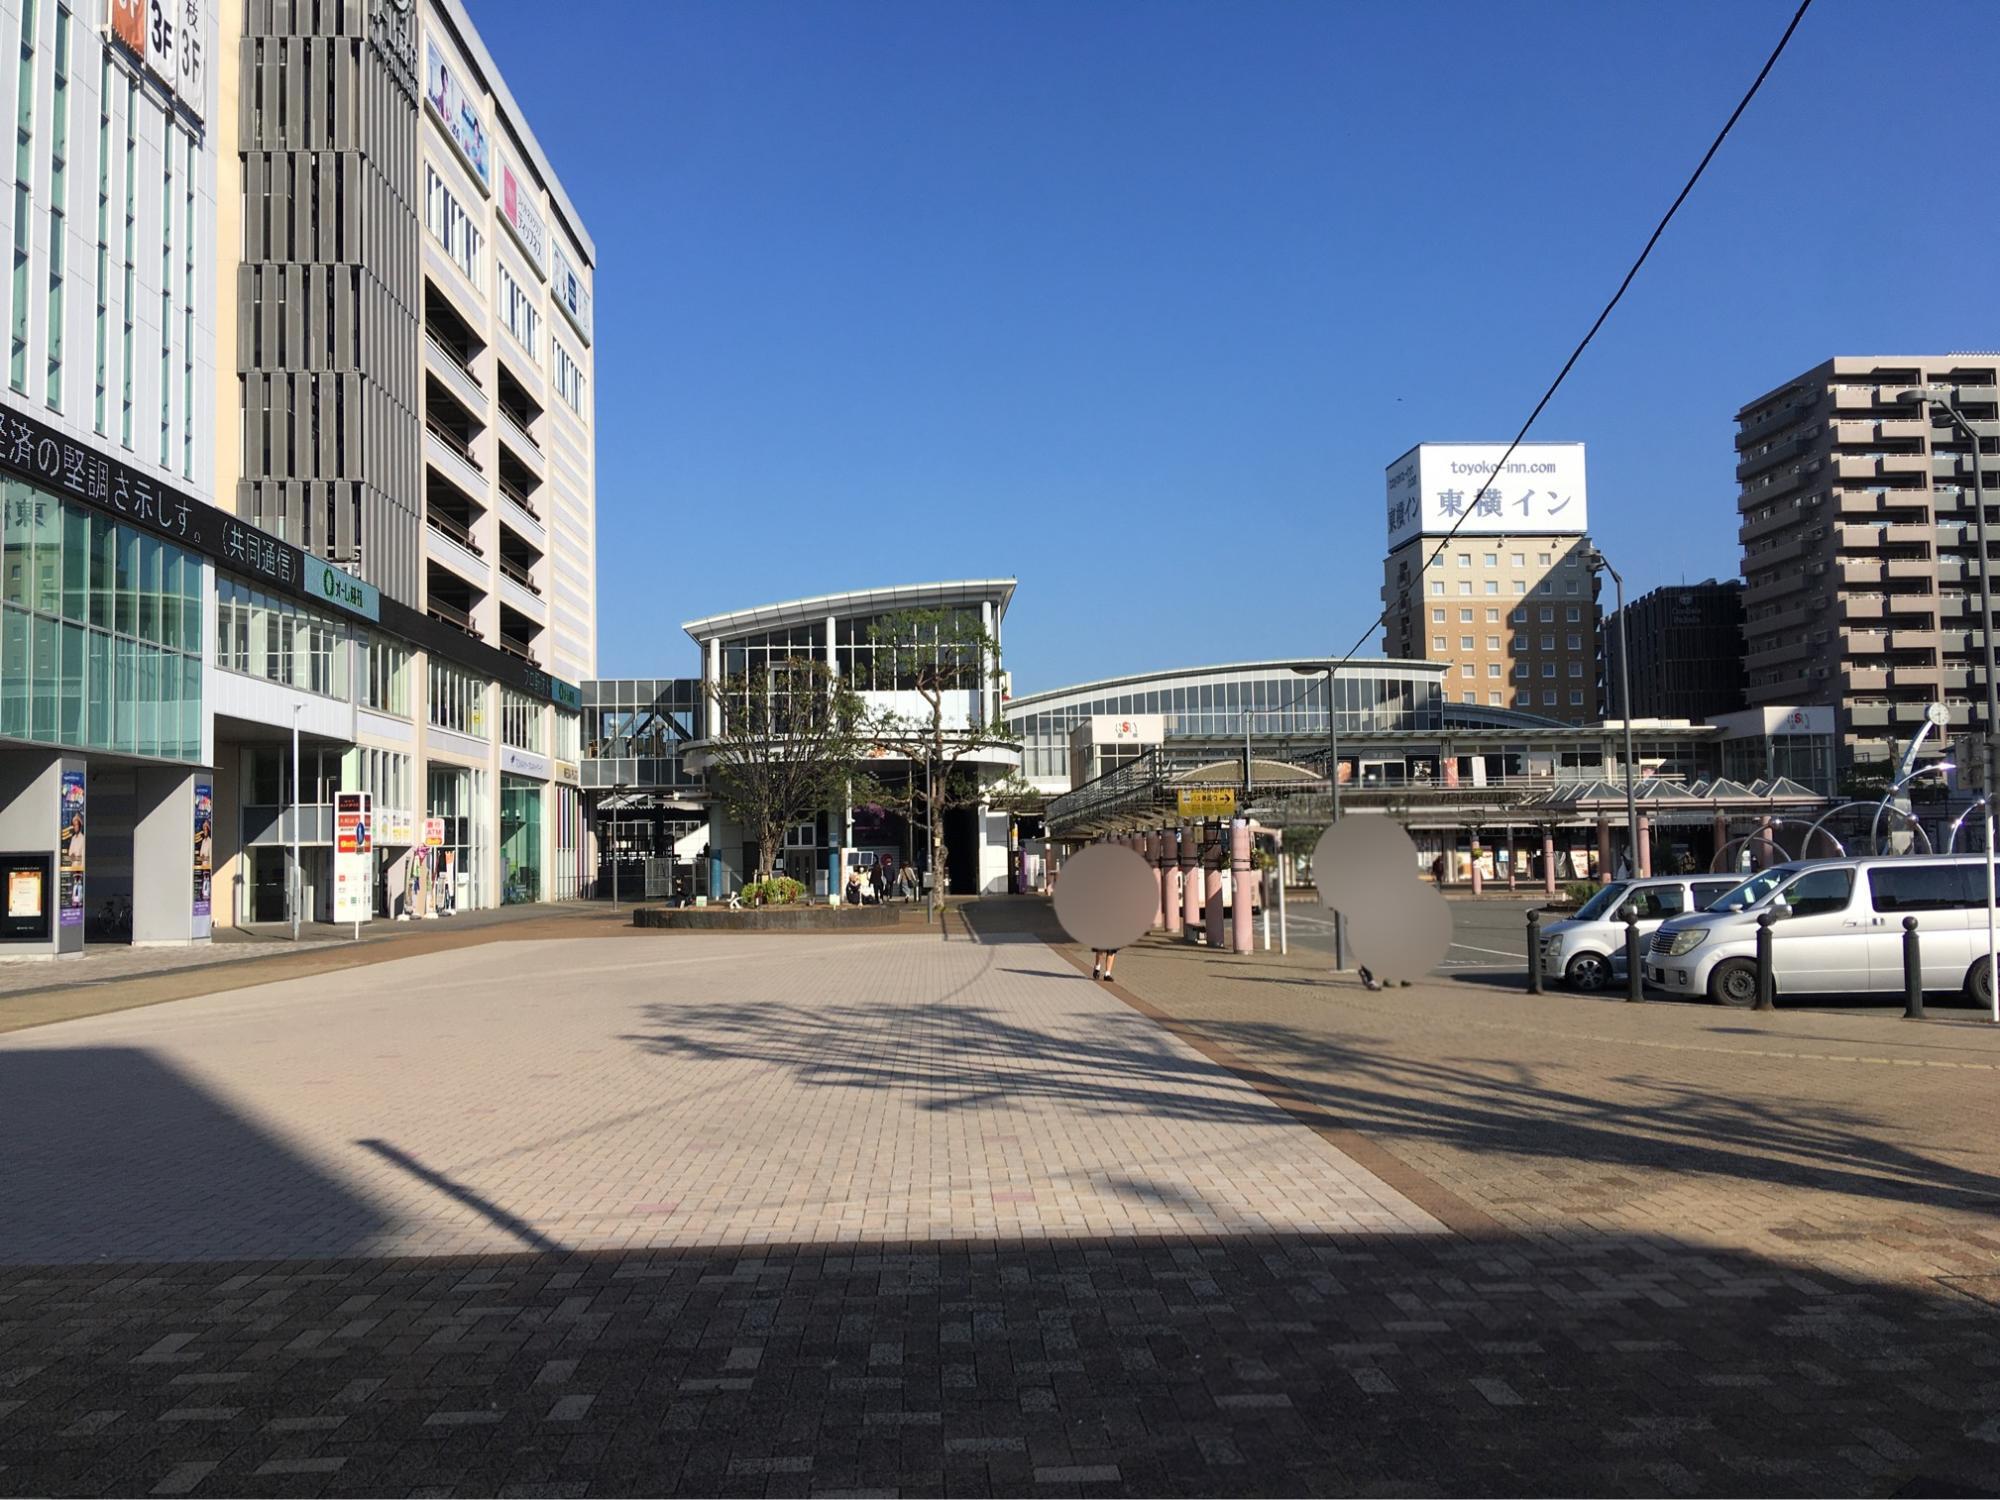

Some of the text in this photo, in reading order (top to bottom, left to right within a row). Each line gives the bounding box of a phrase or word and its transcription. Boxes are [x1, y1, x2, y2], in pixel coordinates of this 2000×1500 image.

[151, 0, 173, 60] 3F
[182, 29, 201, 84] 3F
[1451, 460, 1556, 476] toyoko-inn.com
[1437, 488, 1571, 518] 東横イン
